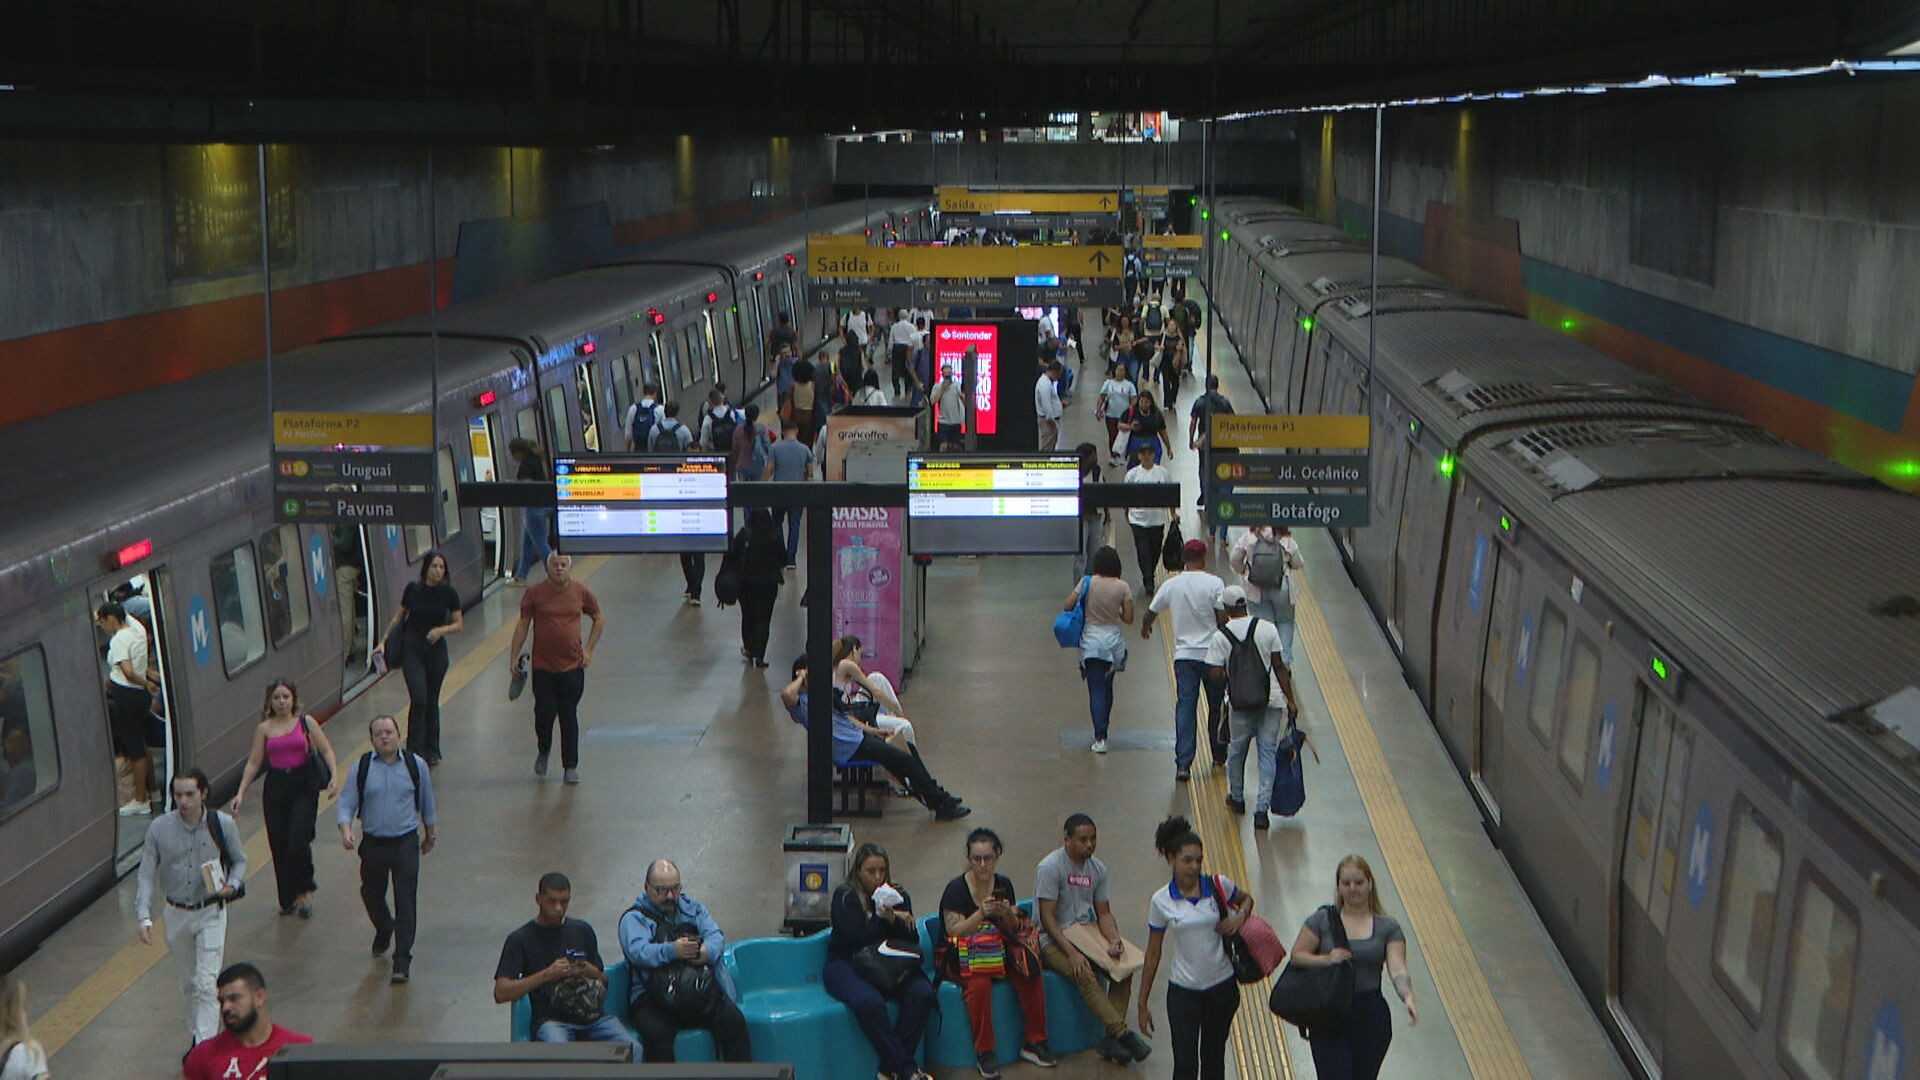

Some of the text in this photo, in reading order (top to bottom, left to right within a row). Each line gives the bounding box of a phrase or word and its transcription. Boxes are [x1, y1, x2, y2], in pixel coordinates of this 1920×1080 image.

[945, 199, 975, 209] Saída
[817, 256, 901, 273] Saída Exit
[940, 289, 977, 298] Presidente
[978, 289, 1003, 298] Wilson
[1045, 289, 1065, 298] Santa
[951, 330, 993, 341] Santander
[283, 418, 360, 430] Plataforma P2
[1219, 420, 1295, 432] Plataforma P1
[838, 430, 889, 441] grancoffee
[341, 463, 391, 480] Uruguai
[1278, 465, 1297, 480] Jd.
[1301, 465, 1359, 480] Oceânico
[286, 502, 297, 513] L2
[337, 500, 394, 517] Pavuna
[1220, 504, 1232, 516] L2
[1272, 502, 1341, 523] Botafogo
